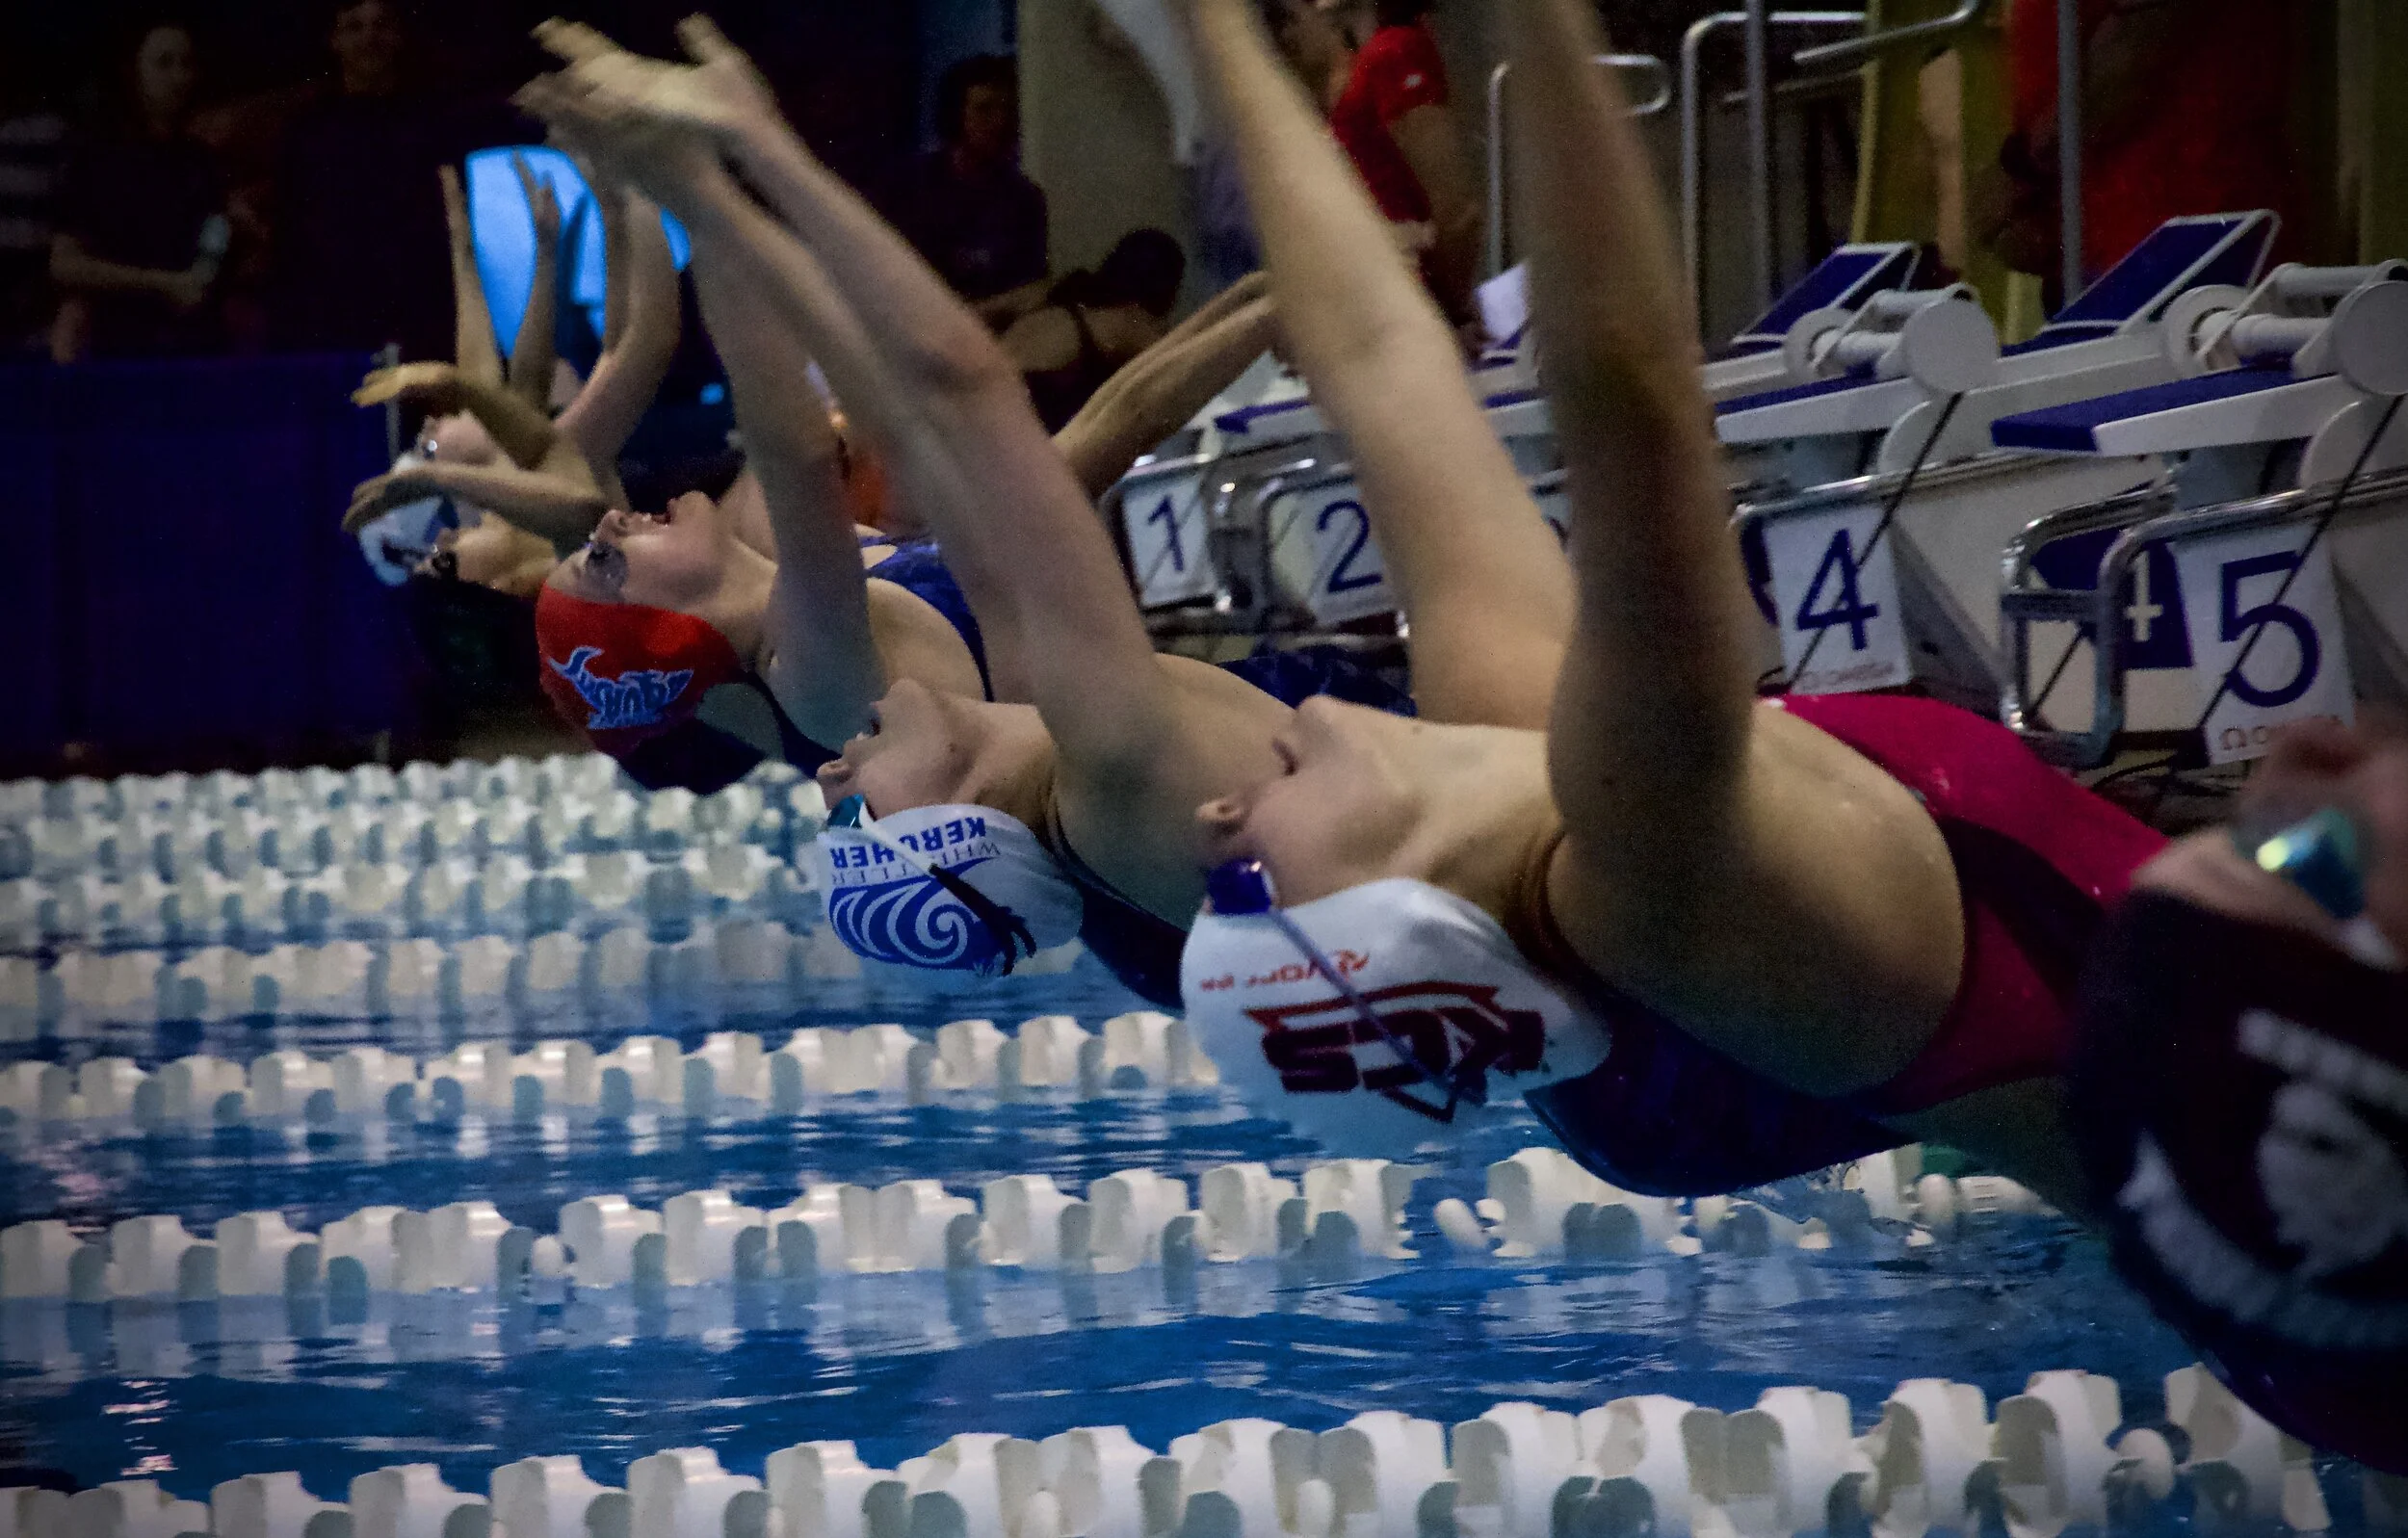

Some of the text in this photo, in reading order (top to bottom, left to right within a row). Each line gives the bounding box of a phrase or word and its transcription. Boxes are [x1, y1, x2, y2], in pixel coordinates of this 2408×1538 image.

[1147, 495, 1184, 572] 1
[1317, 499, 1382, 593] 2
[1797, 530, 1878, 650] 4
[2221, 550, 2320, 707] 5
